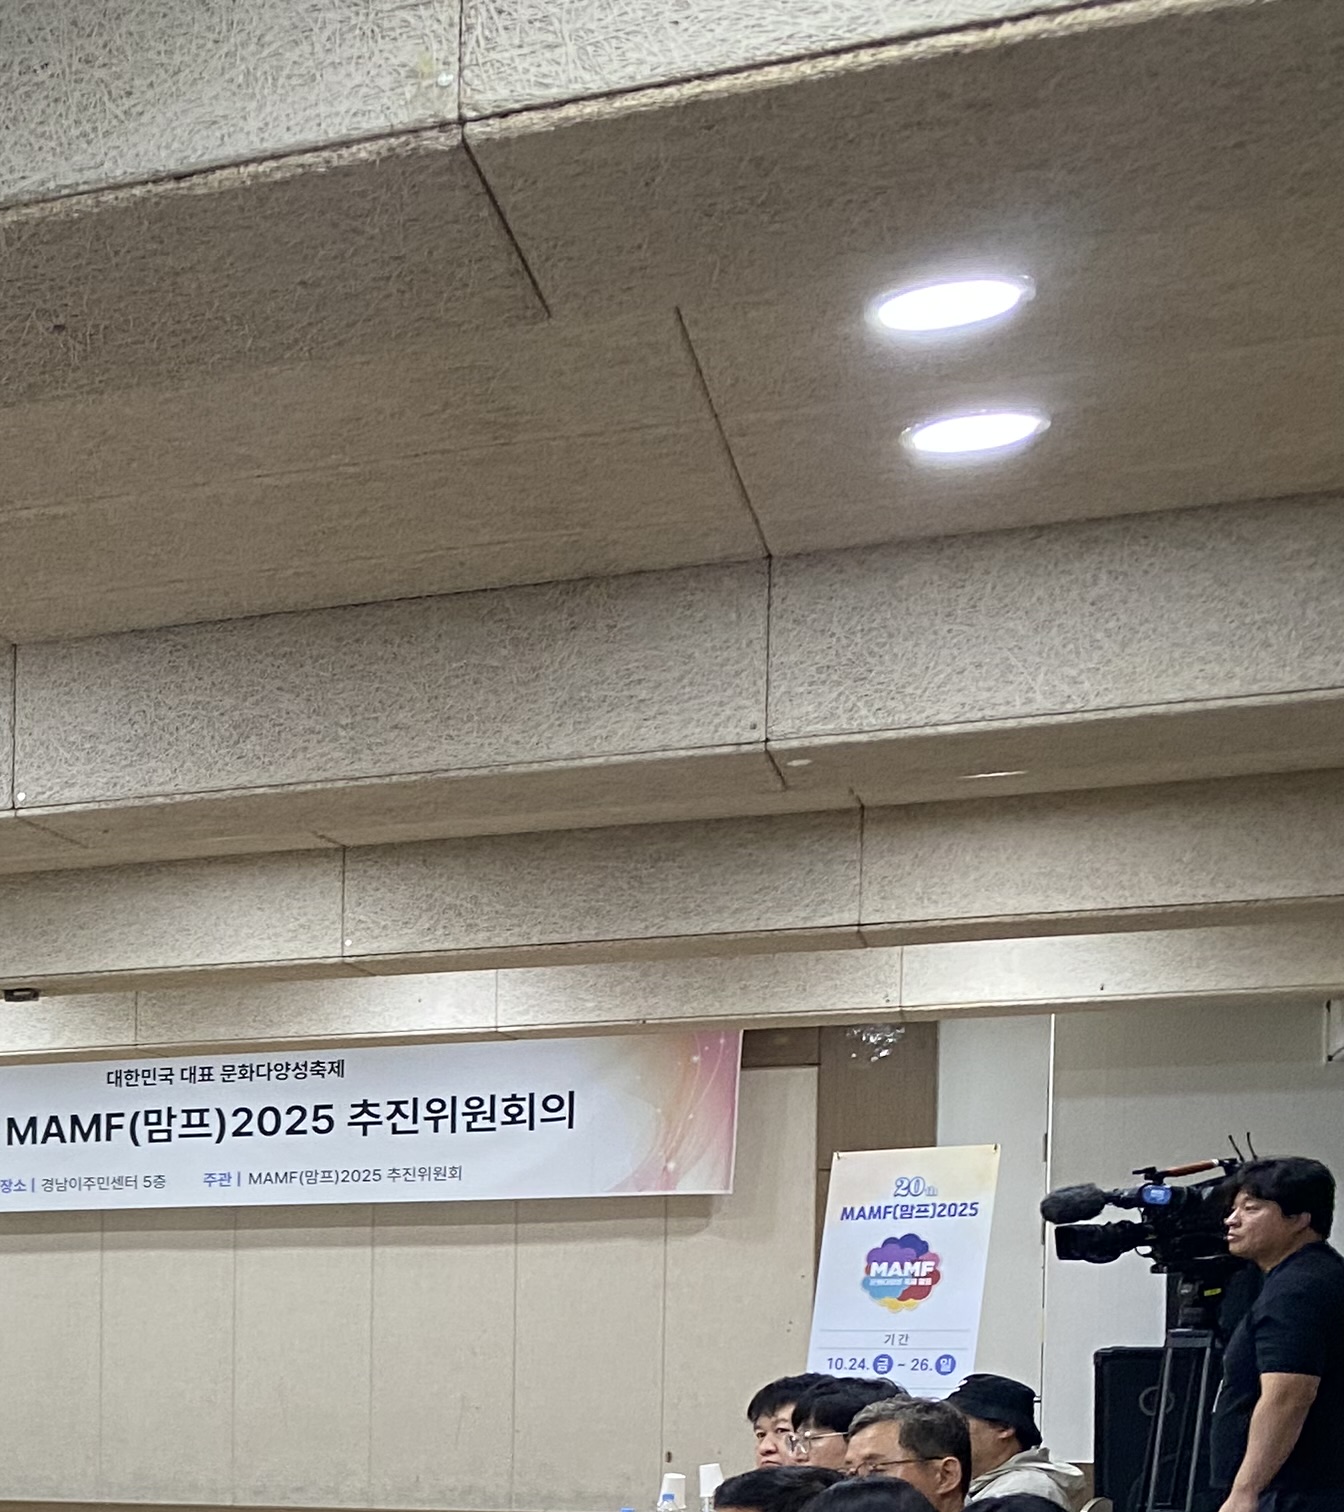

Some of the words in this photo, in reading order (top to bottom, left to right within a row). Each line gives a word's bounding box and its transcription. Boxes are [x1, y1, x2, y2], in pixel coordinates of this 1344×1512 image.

[106, 1067, 175, 1088] 대한민국
[180, 1065, 215, 1084] 대표
[220, 1059, 344, 1083] 문화다양성축제
[7, 1104, 334, 1147] MAMF(맘프)2025
[347, 1090, 575, 1136] 추진위원회의
[0, 1179, 26, 1193] 장소
[41, 1175, 137, 1192] 경남이주민센터
[143, 1175, 166, 1189] 5층
[203, 1172, 232, 1187] 주관
[249, 1169, 381, 1186] MAMF(맘프)2025
[387, 1165, 462, 1182] 추진위원회
[869, 1261, 936, 1277] MAMF
